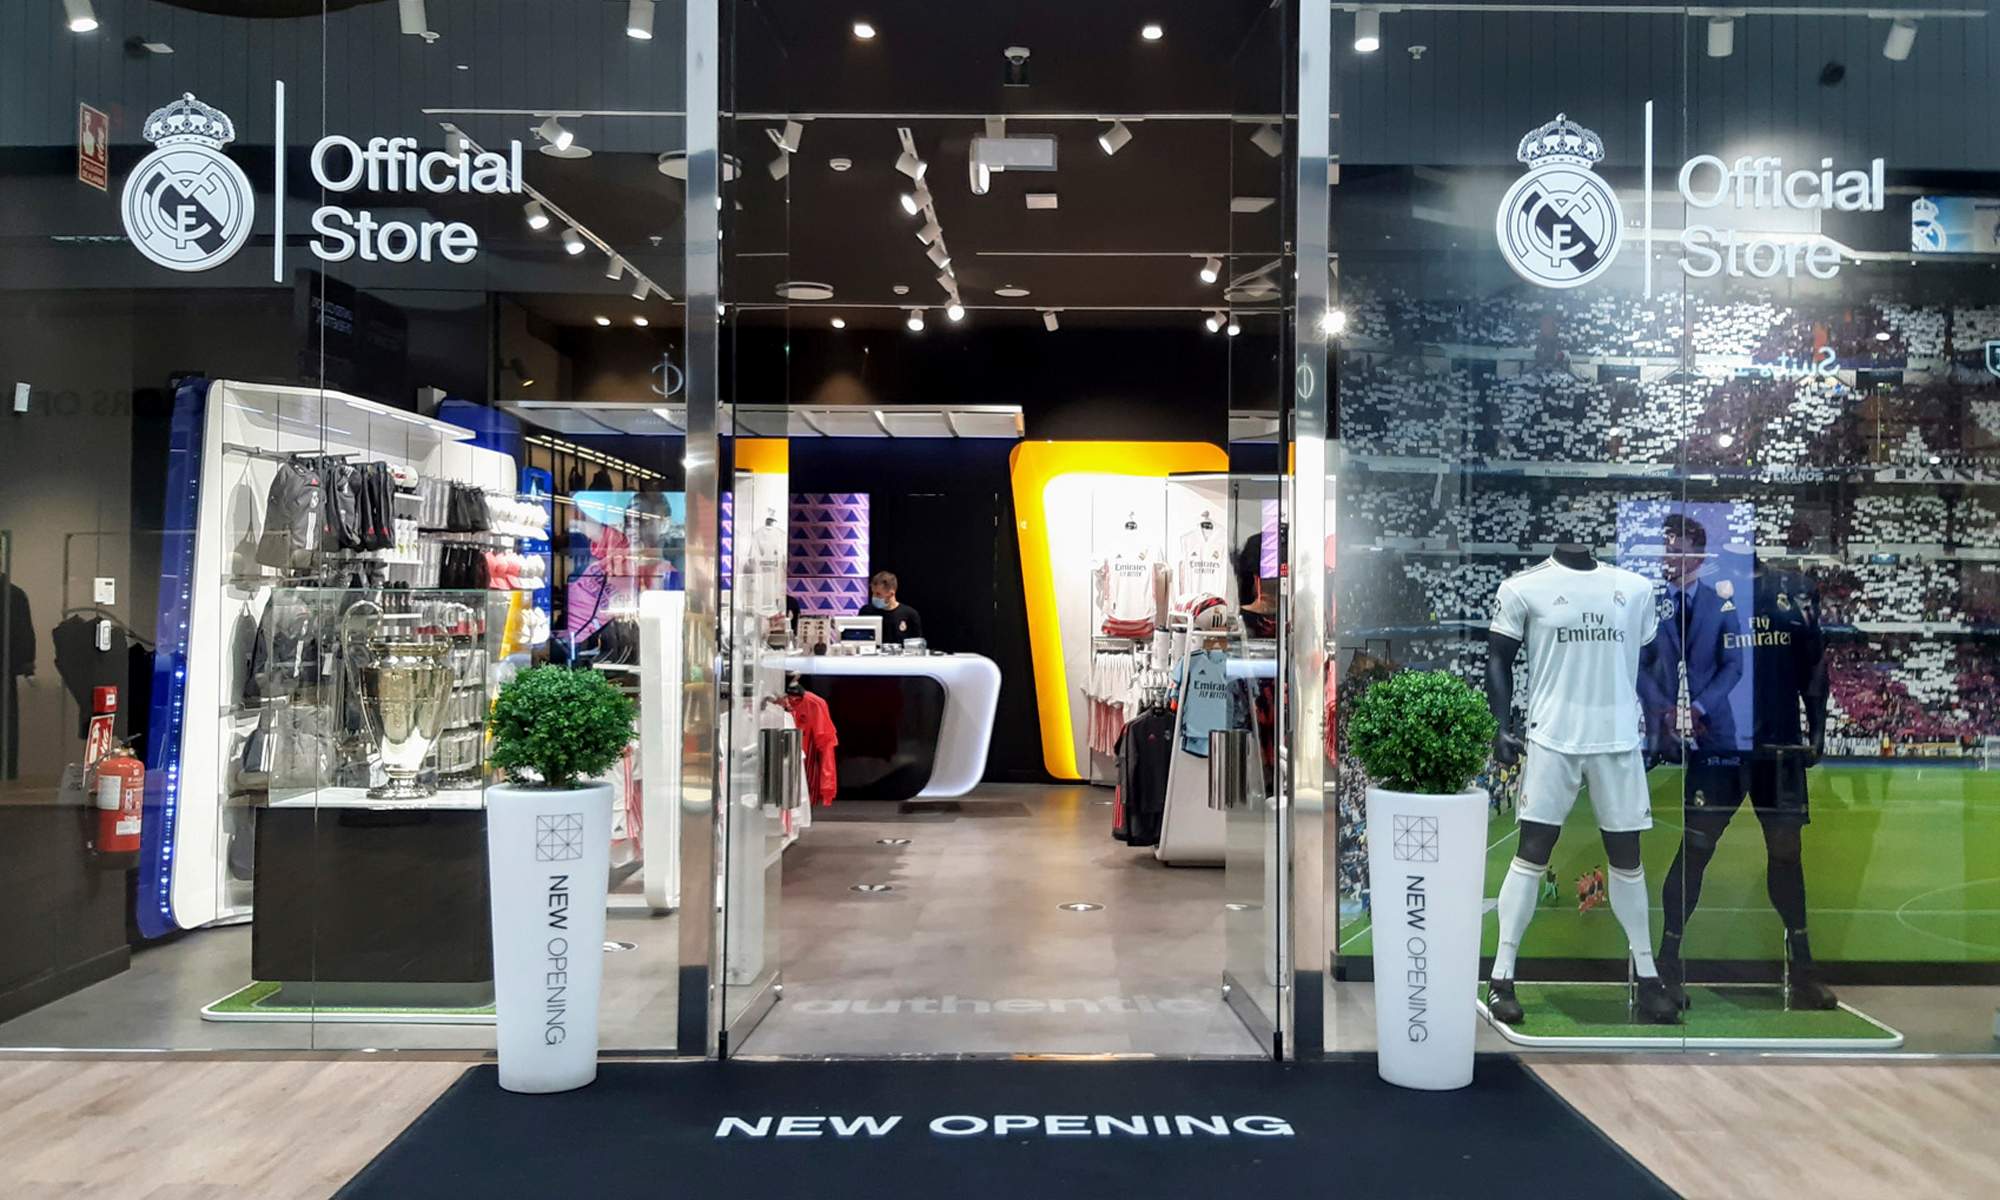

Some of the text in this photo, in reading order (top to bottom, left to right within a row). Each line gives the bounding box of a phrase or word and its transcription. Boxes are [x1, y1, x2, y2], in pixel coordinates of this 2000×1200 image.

[310, 135, 523, 193] Official
[1678, 154, 1885, 211] Official
[309, 205, 479, 263] Store
[1678, 224, 1841, 279] Store
[1556, 626, 1625, 644] Emirates
[1581, 612, 1604, 625] Fly
[1749, 616, 1771, 630] Fly
[545, 874, 569, 1046] NEW OPENING
[1406, 875, 1428, 1043] NEW OPENING
[714, 1115, 1296, 1138] NEW OPENING
